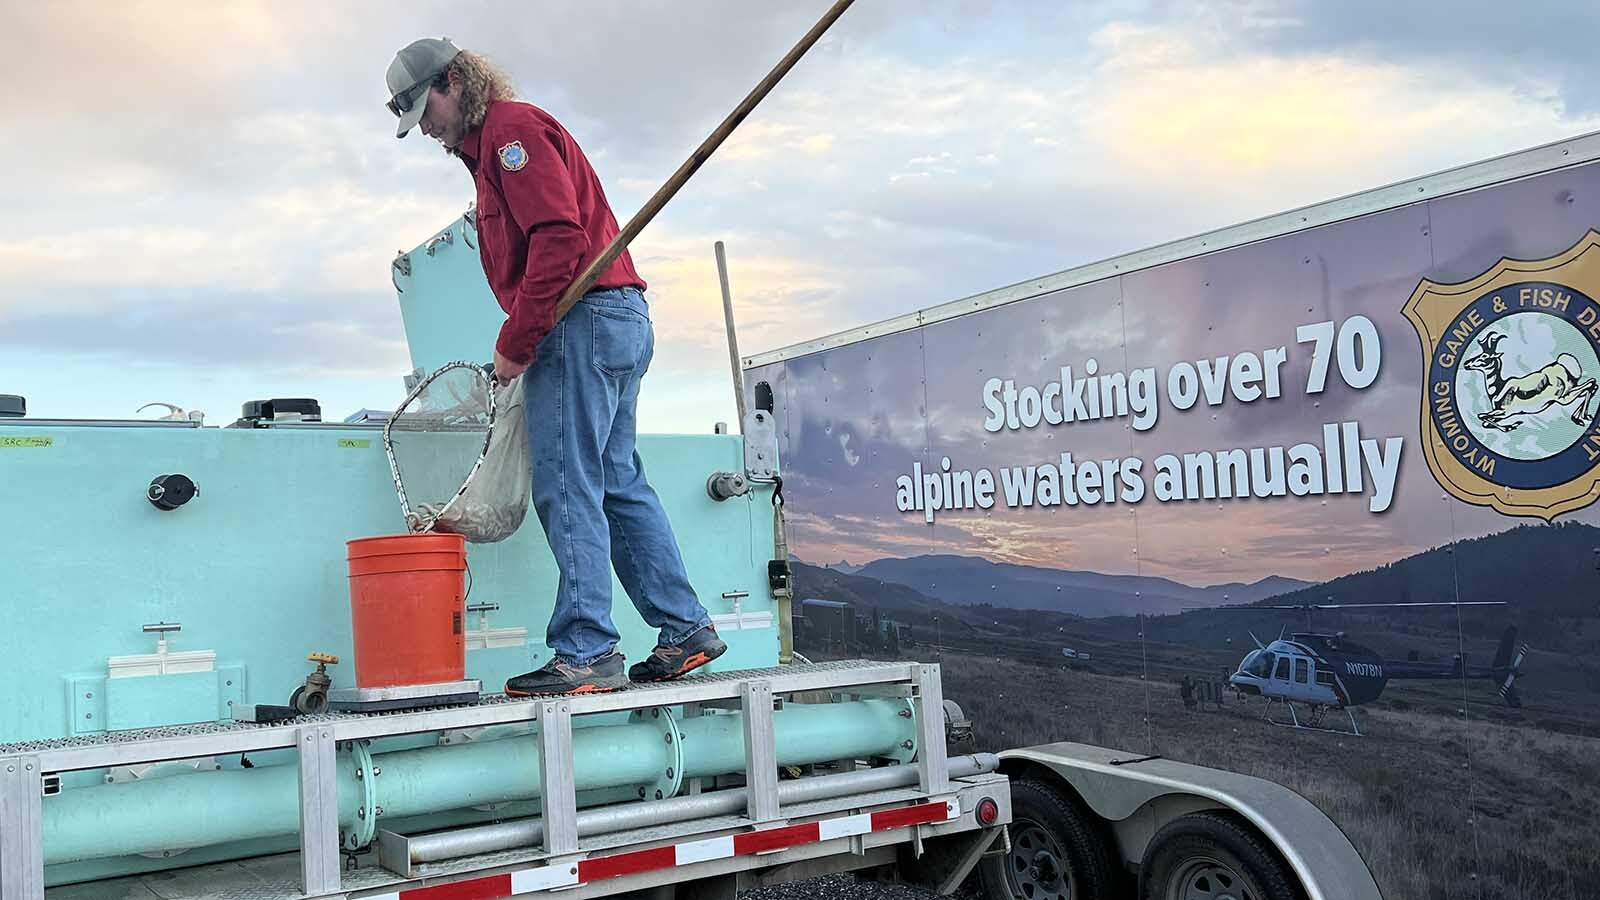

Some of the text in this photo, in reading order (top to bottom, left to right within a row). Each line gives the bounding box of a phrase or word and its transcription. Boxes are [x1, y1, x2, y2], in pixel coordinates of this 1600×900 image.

[983, 314, 1382, 432] Stocking over 70
[1434, 288, 1600, 476] WYOMING GAME & FISH DE
[896, 421, 1404, 523] alpine waters annually
[1345, 662, 1383, 678] N1078N
